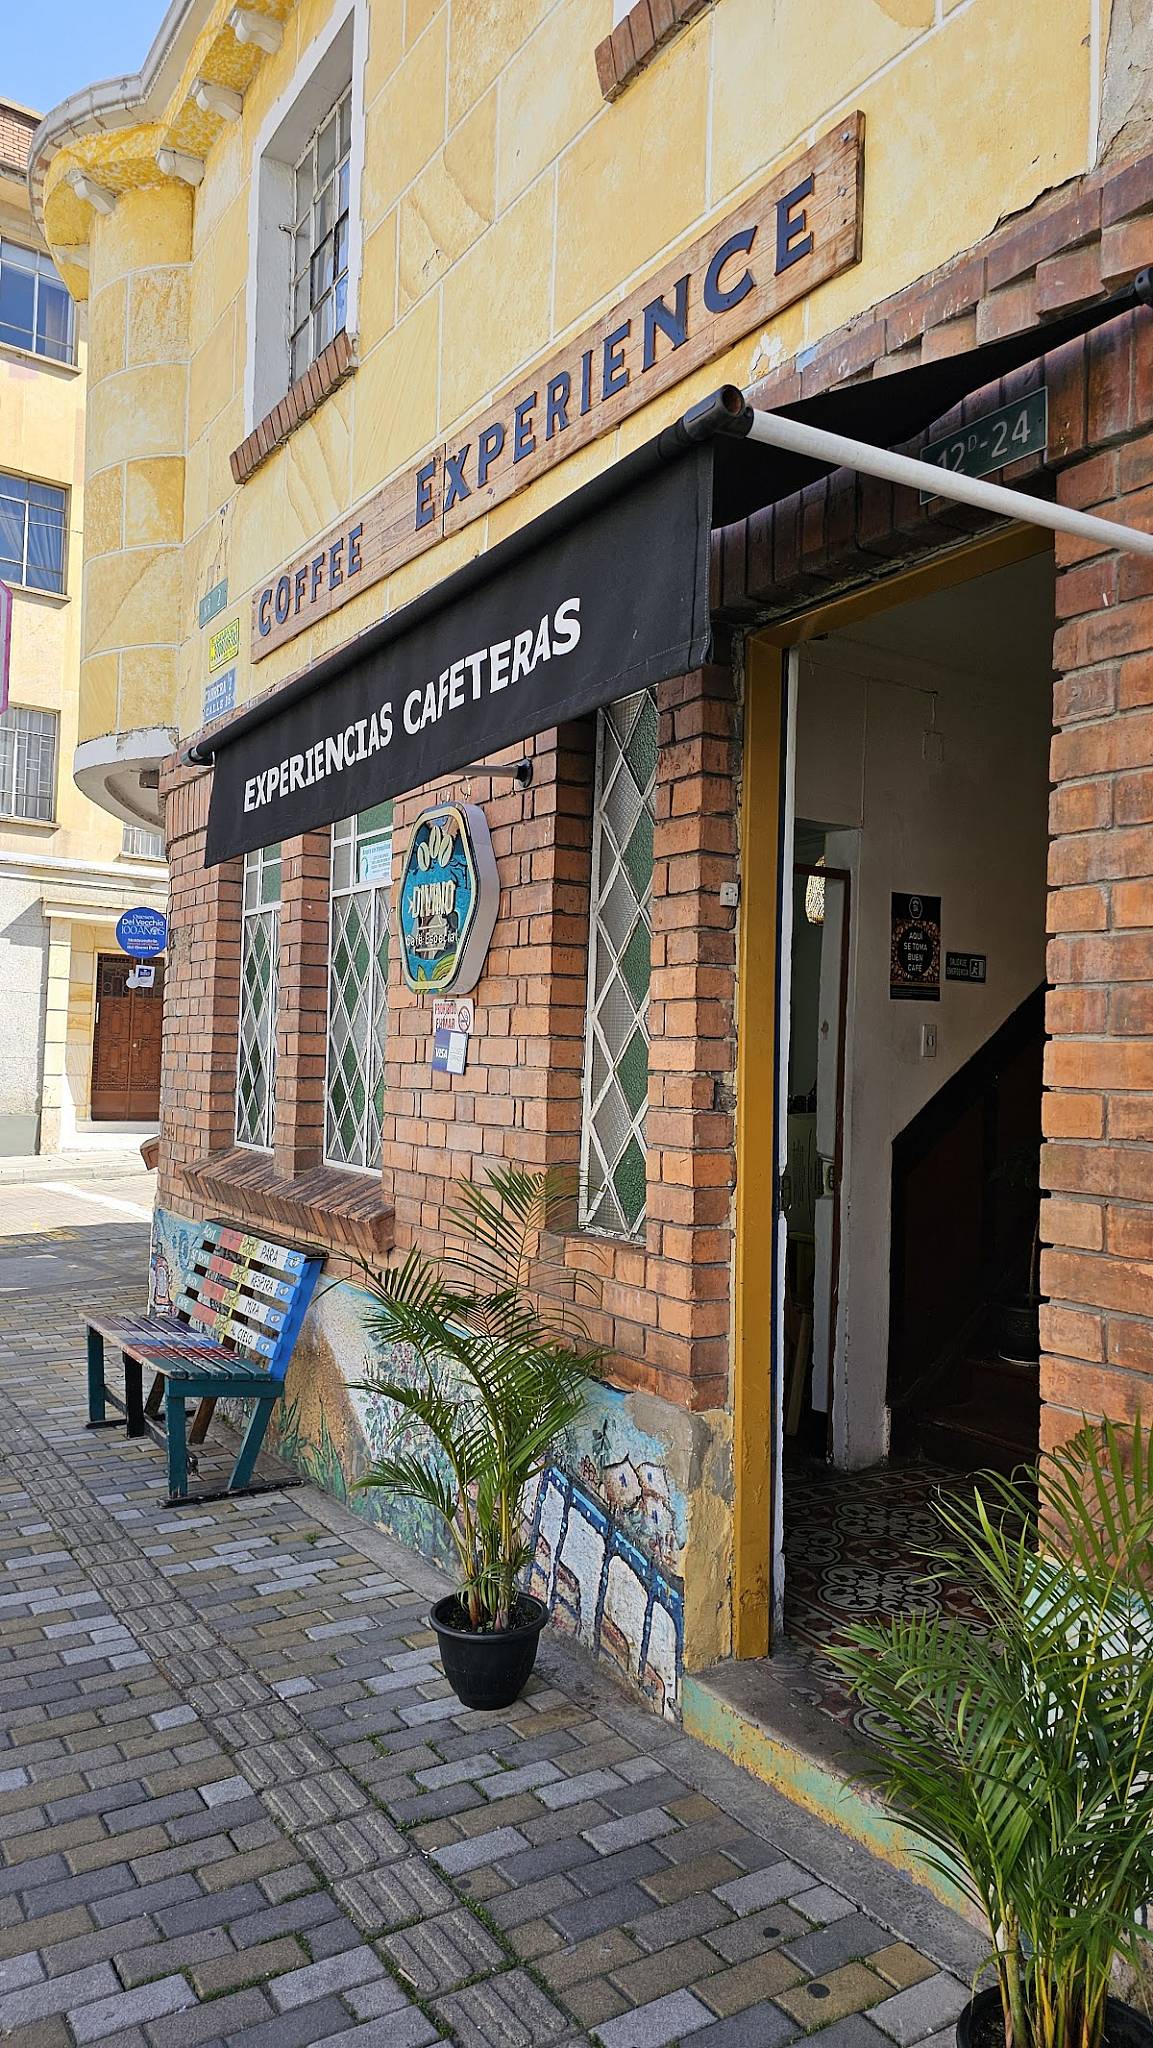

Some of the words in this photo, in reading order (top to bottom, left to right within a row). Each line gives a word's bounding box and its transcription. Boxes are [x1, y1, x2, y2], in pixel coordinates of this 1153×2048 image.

[258, 522, 363, 637] COFFEE
[415, 172, 815, 531] EXPERIENCE
[243, 702, 393, 813] EXPERIENCIAS
[403, 597, 581, 736] CAFETERAS
[405, 933, 423, 947] Café
[425, 929, 458, 945] Especial
[903, 942, 912, 950] SE
[912, 943, 928, 951] TOMA
[907, 953, 924, 961] BUEN
[435, 1047, 448, 1060] VISA
[260, 1244, 279, 1264] PARA
[251, 1272, 274, 1293] RESPIRA
[244, 1300, 260, 1315] MIRA
[237, 1327, 253, 1344] CIELO
